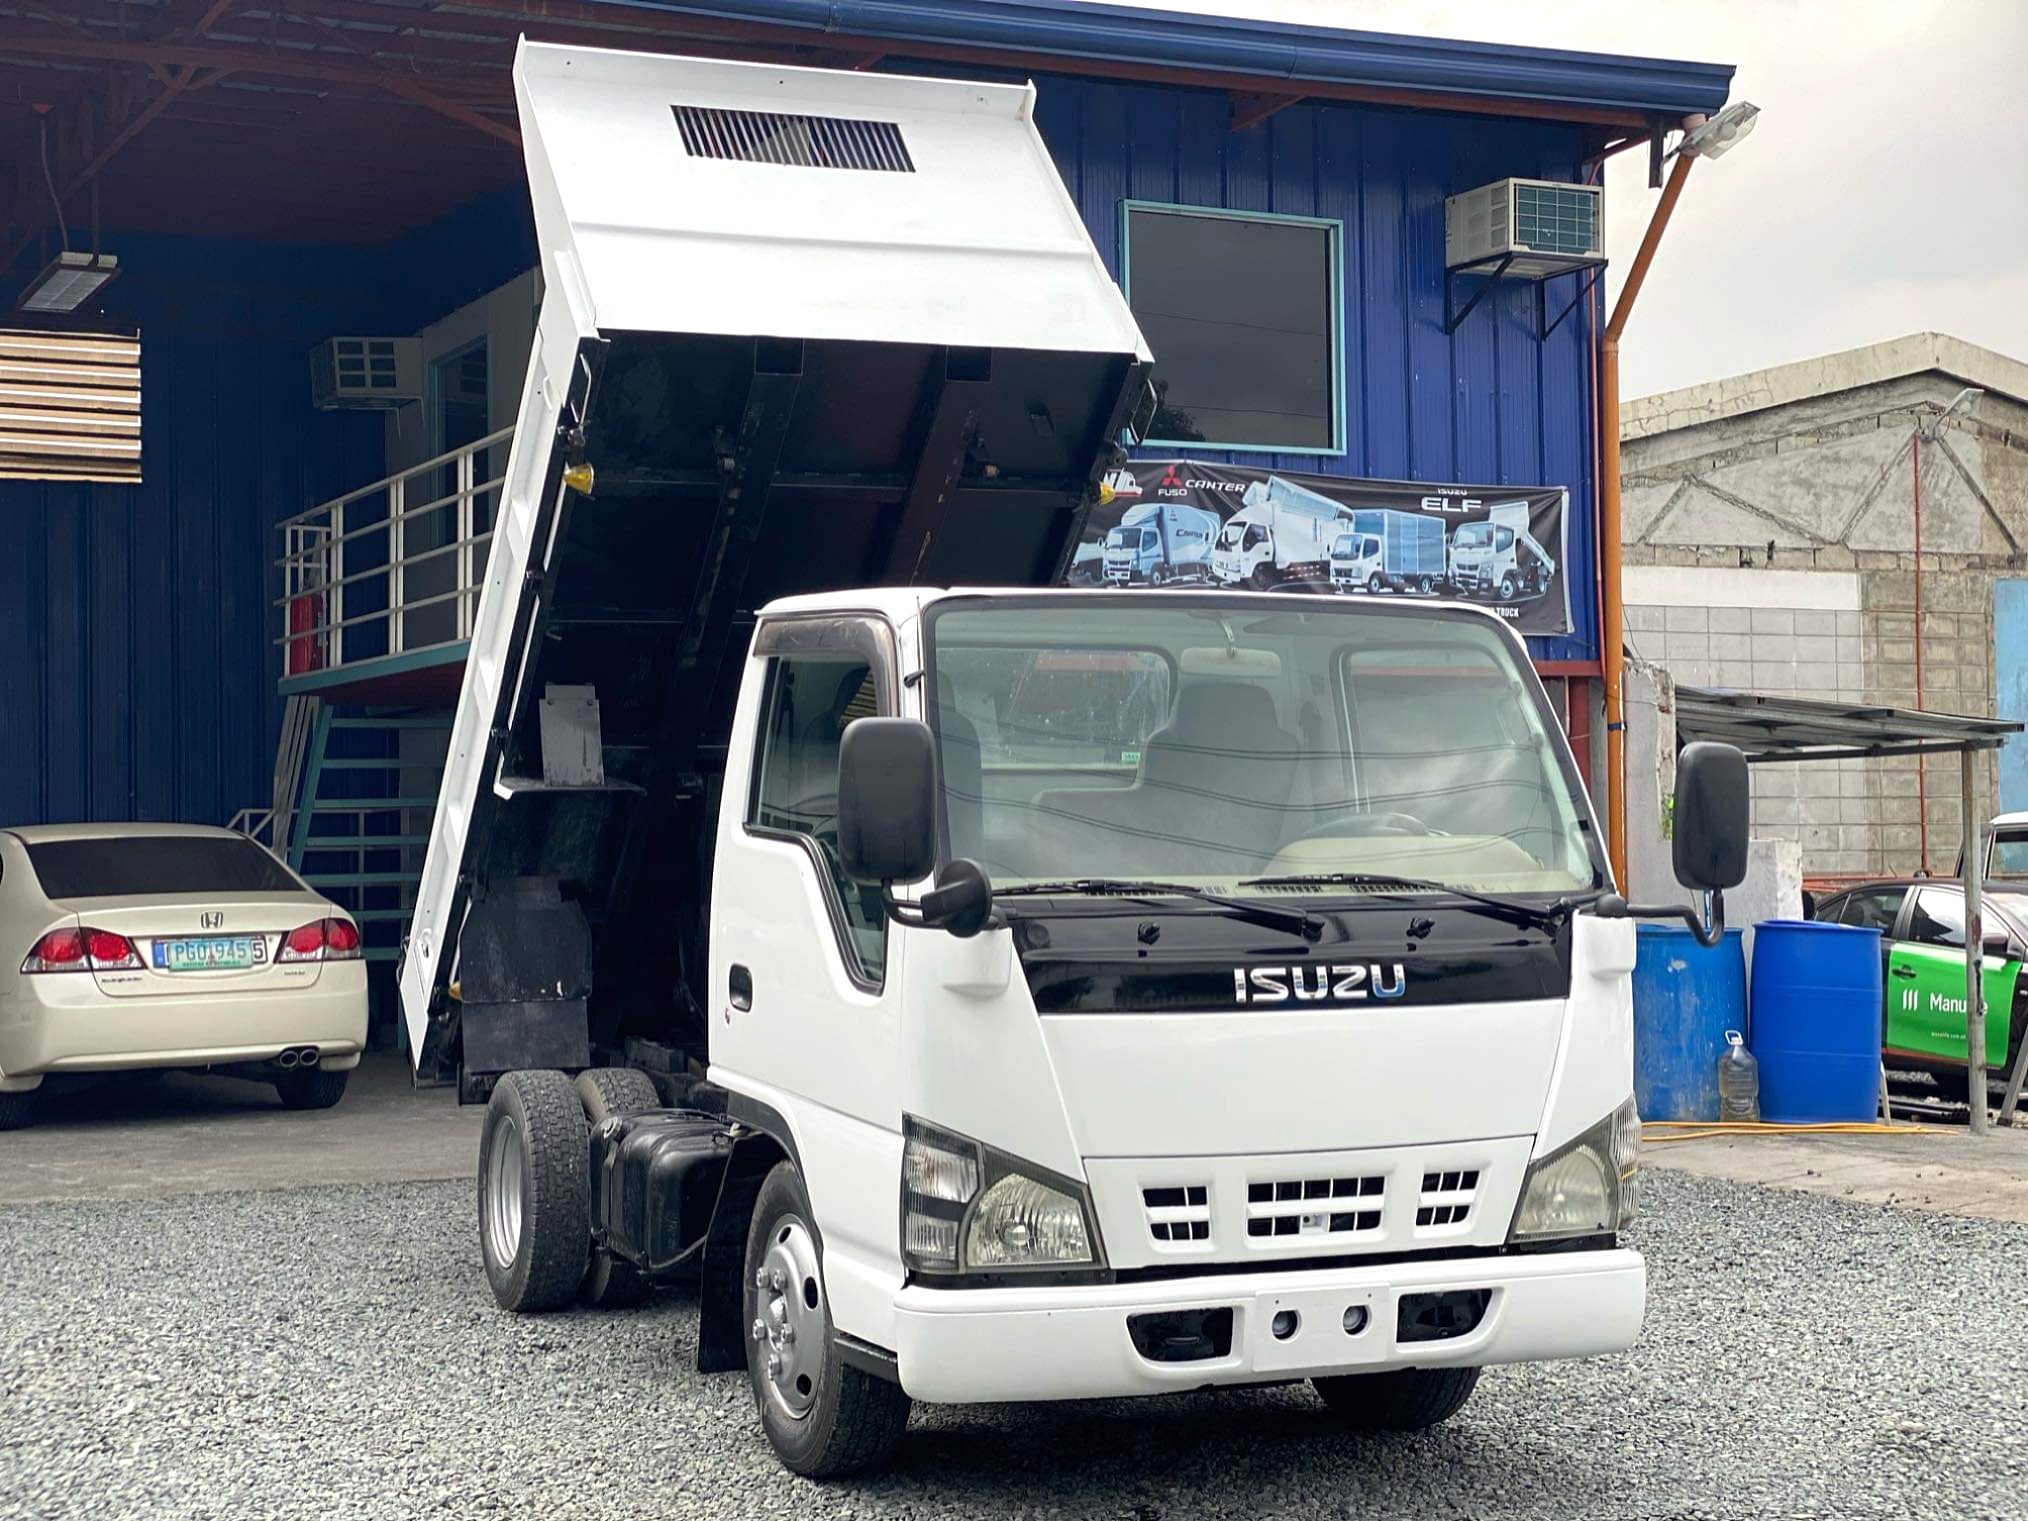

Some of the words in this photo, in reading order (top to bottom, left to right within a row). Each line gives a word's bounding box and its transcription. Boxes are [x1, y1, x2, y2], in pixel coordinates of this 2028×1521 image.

[1157, 488, 1188, 496] FUSO
[1185, 479, 1246, 493] CANTER
[1437, 487, 1468, 496] ISUZU
[1421, 496, 1482, 512] ELF
[1496, 607, 1519, 617] TRUCK
[215, 940, 247, 960] 945
[1233, 963, 1406, 1003] ISUZU
[1930, 992, 1988, 1014] Manue
